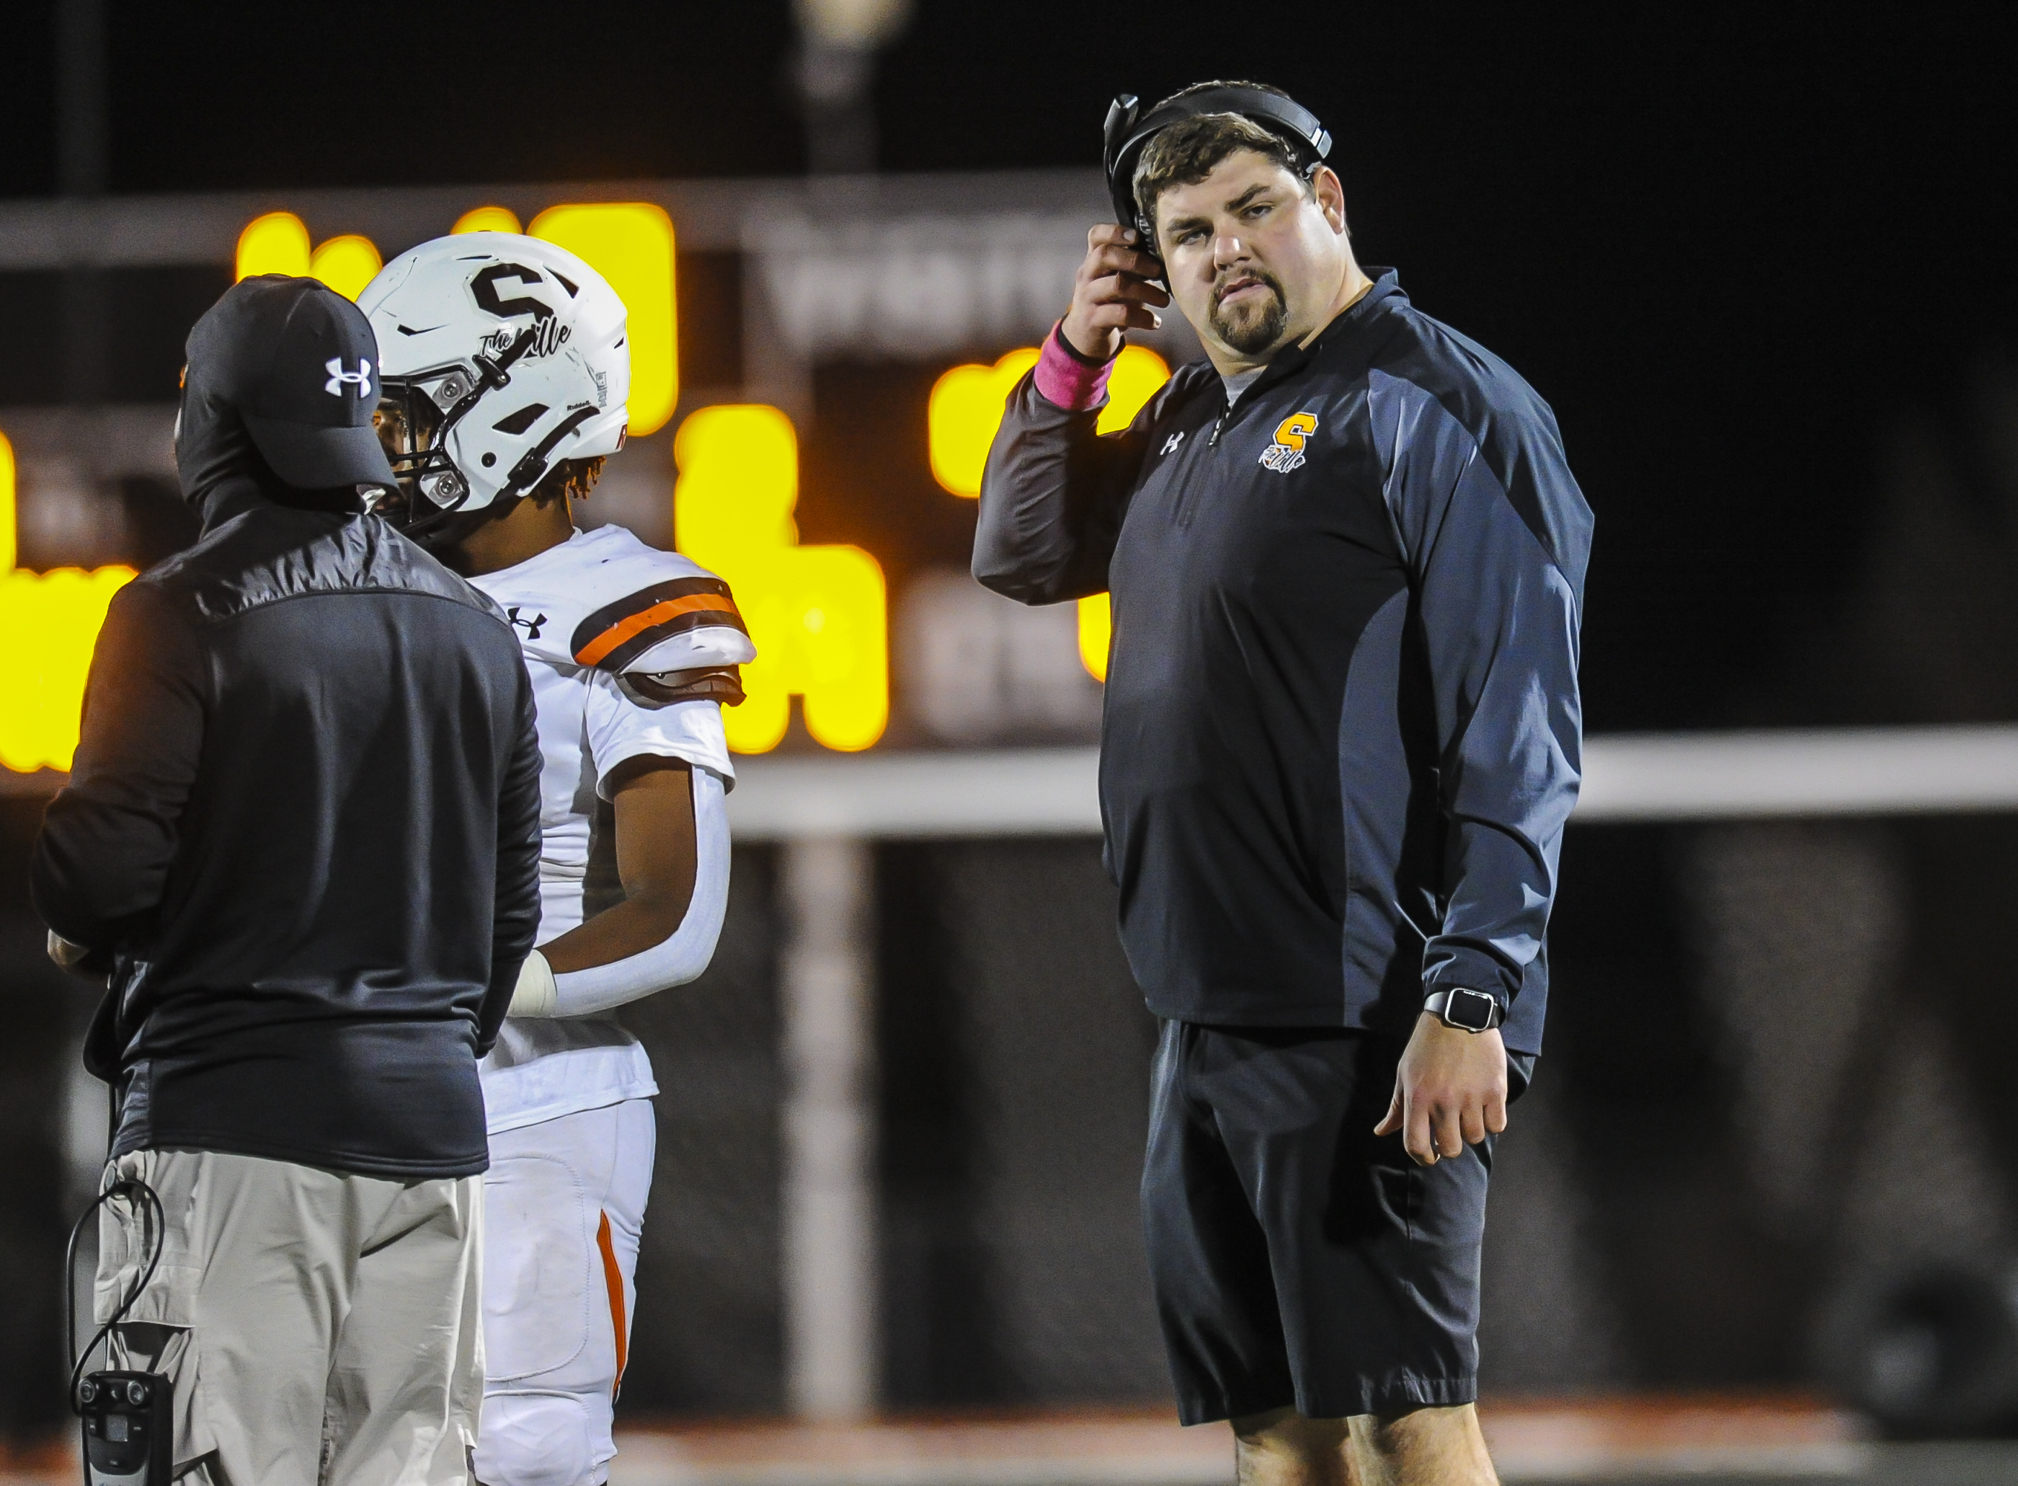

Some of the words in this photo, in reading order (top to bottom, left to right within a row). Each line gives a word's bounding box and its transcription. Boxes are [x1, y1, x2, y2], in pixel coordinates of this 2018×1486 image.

[470, 262, 554, 358] S
[479, 329, 513, 356] The
[1270, 411, 1319, 460] S
